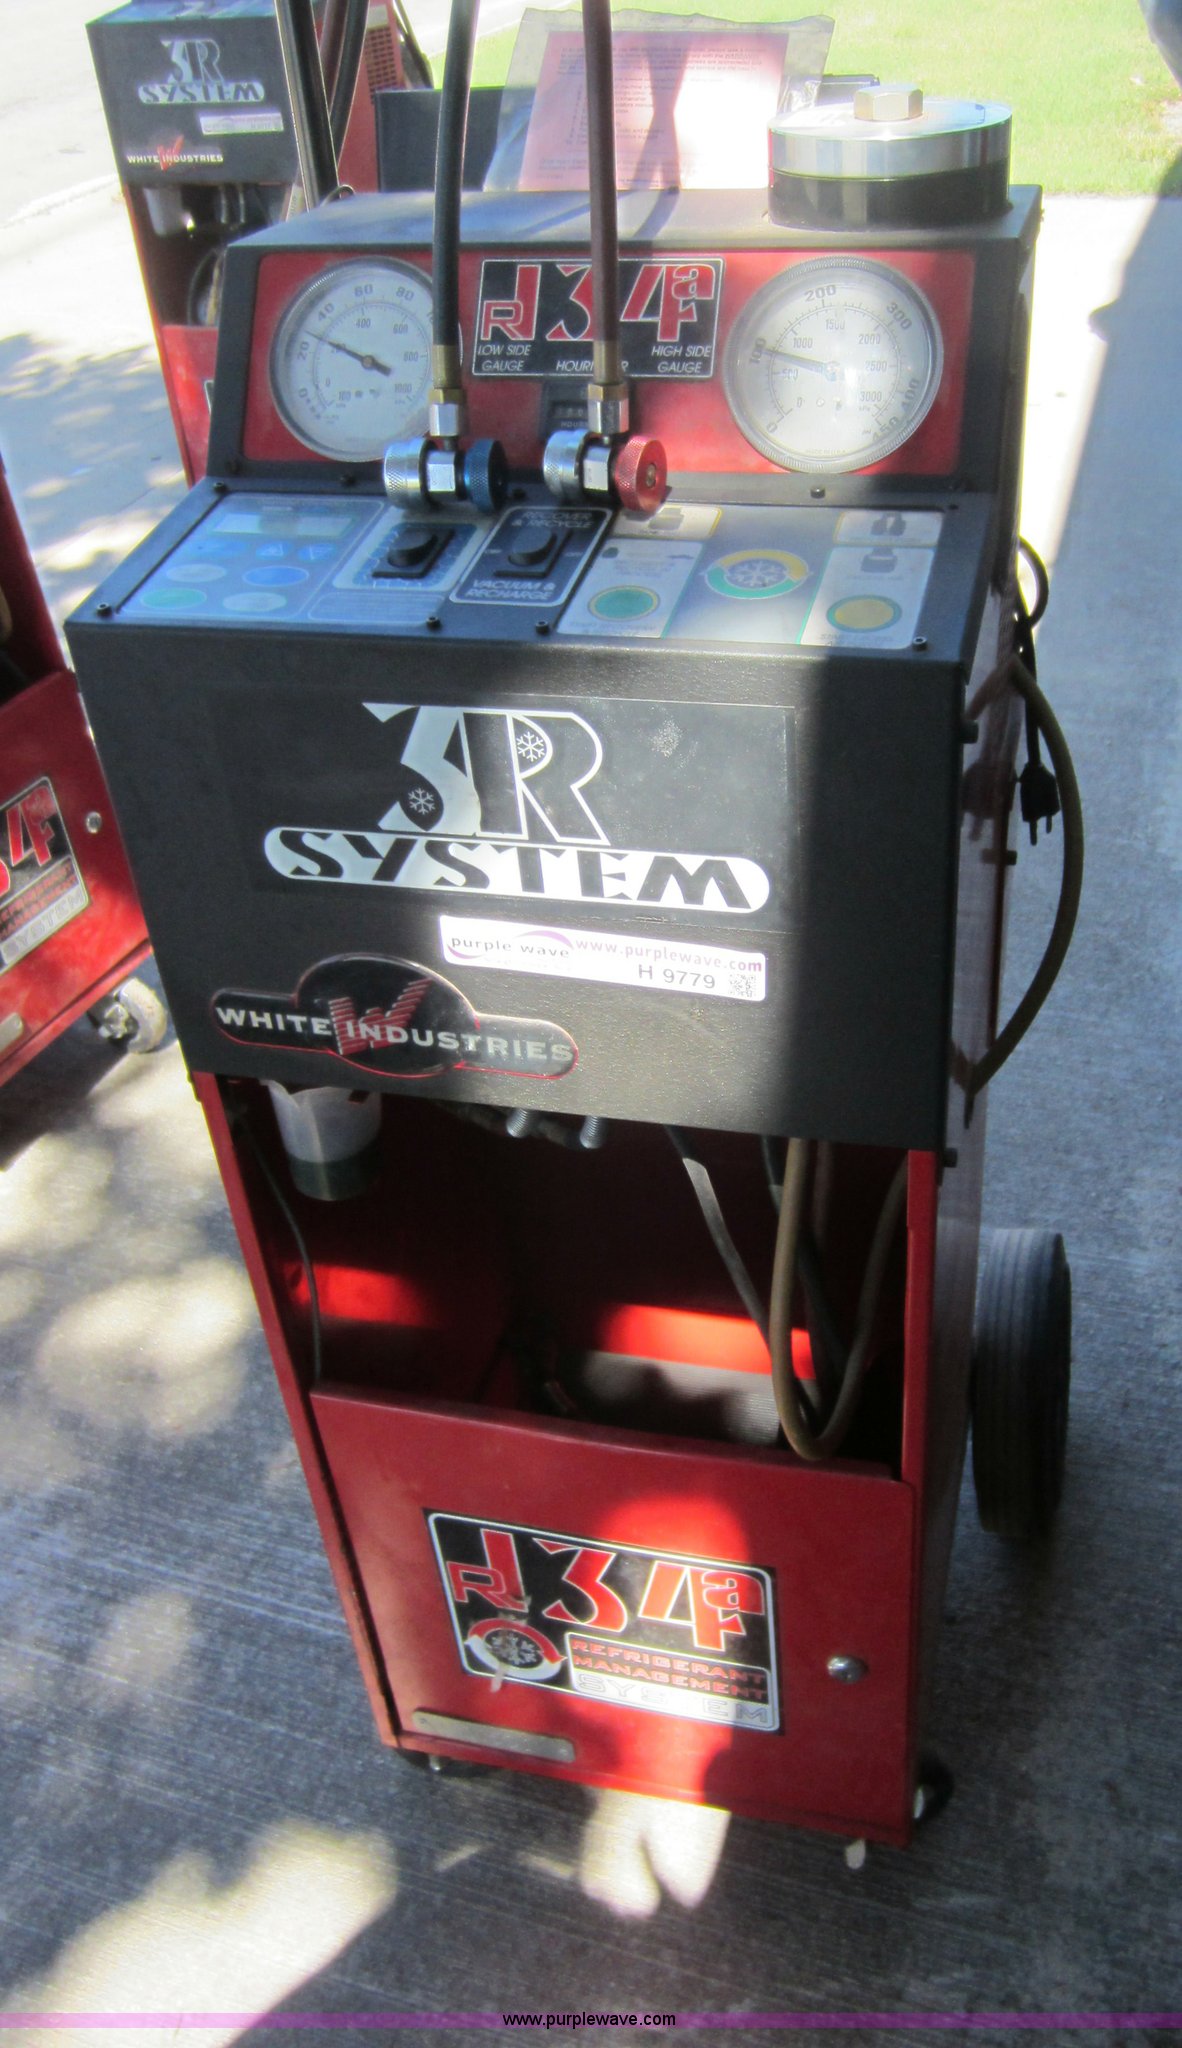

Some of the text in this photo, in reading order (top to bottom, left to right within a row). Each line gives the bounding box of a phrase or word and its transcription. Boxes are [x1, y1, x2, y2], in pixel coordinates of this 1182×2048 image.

[139, 82, 264, 103] SYSTEM
[127, 153, 224, 164] WHITE INDUSTRIES
[354, 284, 373, 297] 60
[395, 286, 414, 301] 80
[804, 285, 836, 302] 200
[317, 303, 335, 321] 40
[886, 302, 912, 331] 300
[355, 318, 371, 329] 400
[825, 318, 845, 330] 1500
[793, 337, 813, 349] 1000
[858, 333, 881, 345] 2000
[477, 345, 531, 356] LOW SIDE
[651, 345, 712, 358] HIGH SIDE
[750, 337, 767, 364] 100
[481, 360, 524, 372] GAUGE
[657, 361, 702, 374] GAUGE
[865, 360, 887, 372] 2500
[782, 368, 798, 381] 500
[796, 397, 803, 408] 0
[860, 391, 882, 402] 3000
[766, 421, 778, 433] 0
[472, 579, 541, 589] VACUUM
[465, 588, 554, 600] RECHARGE
[278, 827, 753, 912] SYSTEM
[450, 935, 569, 959] purple wave
[575, 938, 763, 973] www.purplewave.com
[637, 963, 716, 990] H 9779
[215, 1006, 575, 1063] WHITE INDUSTRIES
[572, 1638, 766, 1685] REFRIGERANT
[573, 1654, 768, 1700] MANAGEMENT
